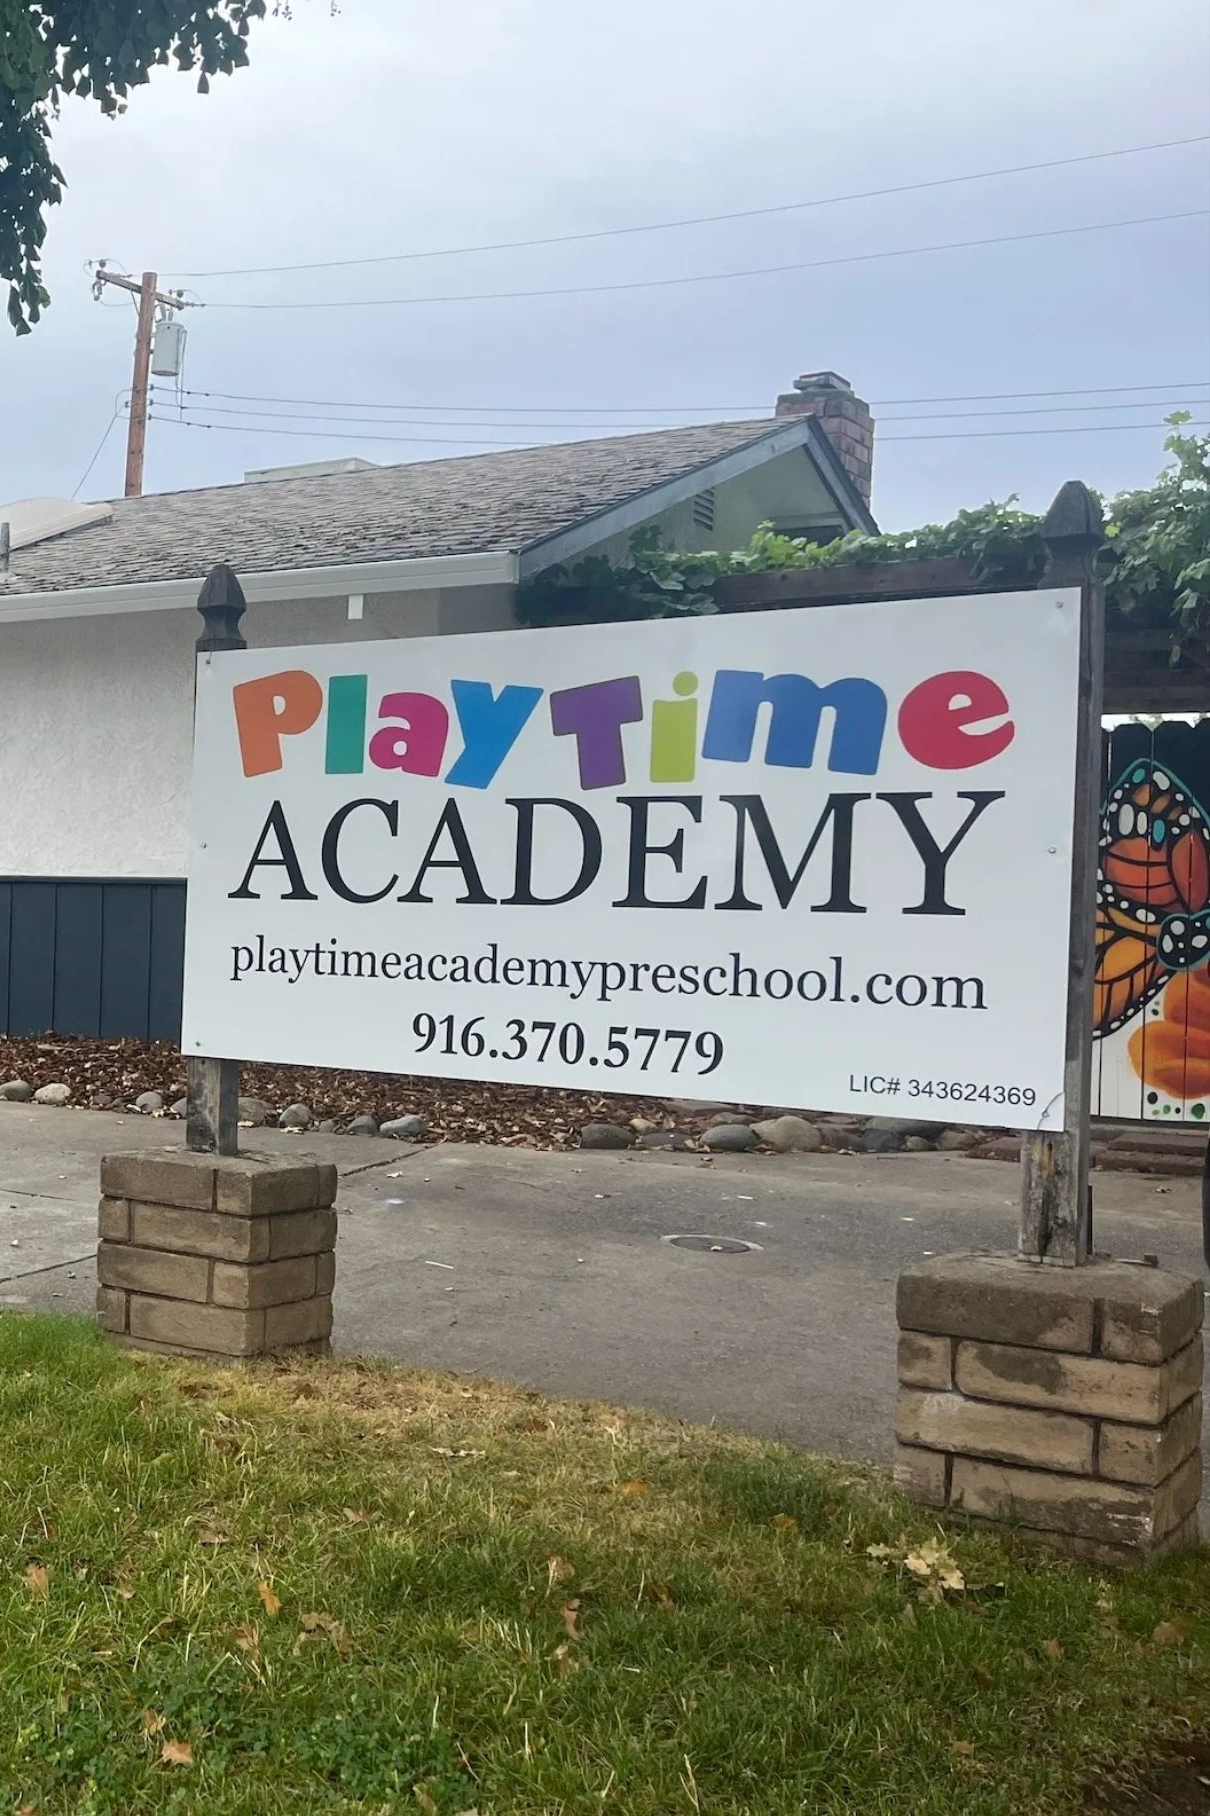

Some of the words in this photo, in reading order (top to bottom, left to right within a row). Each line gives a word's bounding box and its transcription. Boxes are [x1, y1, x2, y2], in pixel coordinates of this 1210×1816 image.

[227, 791, 1006, 915] ACADEMY
[229, 935, 988, 1010] playtimeacademypreschool.com
[412, 1013, 724, 1075] 916.370.5779
[849, 1074, 901, 1096] LIC#
[908, 1079, 1036, 1106] 343624369
